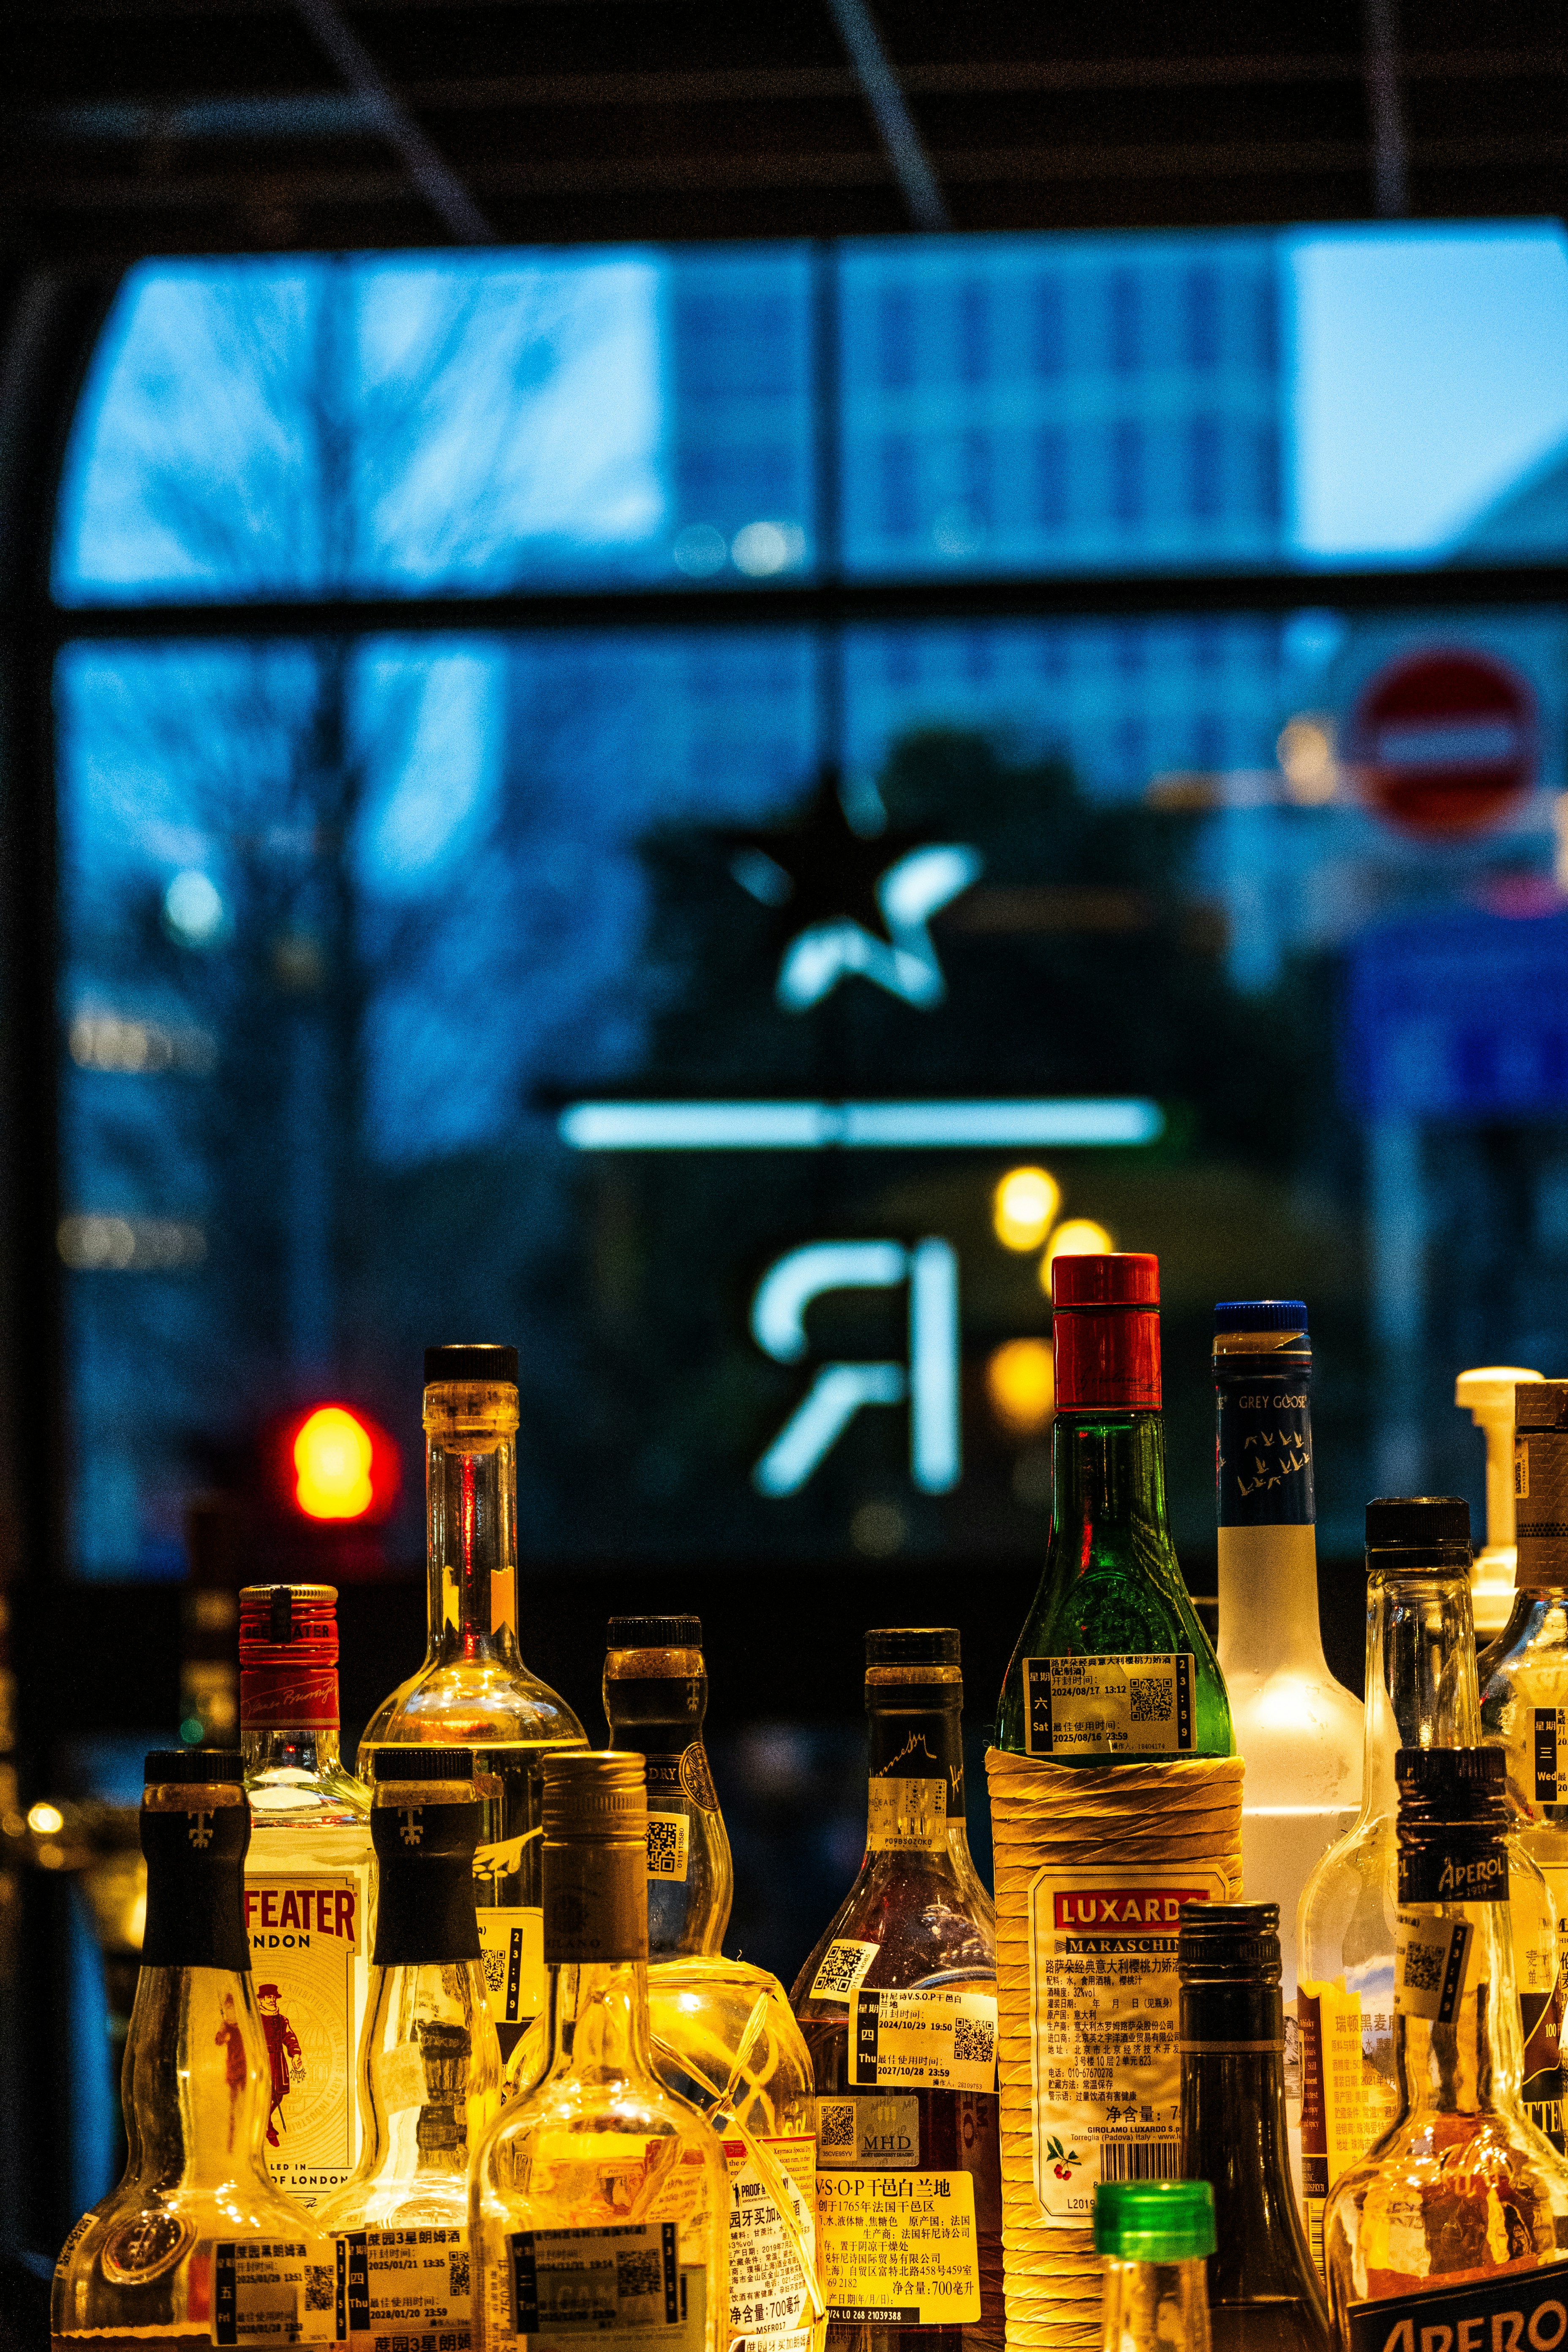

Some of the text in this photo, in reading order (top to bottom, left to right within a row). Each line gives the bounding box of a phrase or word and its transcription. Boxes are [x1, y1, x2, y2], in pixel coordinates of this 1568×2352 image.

[1239, 1395, 1269, 1409] GREY
[1029, 1672, 1050, 1682] 星期
[1051, 1686, 1126, 1696] 2024/08/17 13:12
[1034, 1698, 1048, 1710] 六
[1033, 1723, 1048, 1731] Sat
[1535, 1721, 1556, 1731] 星期
[1054, 1732, 1127, 1742] 2025/08/16 23:59
[1540, 1748, 1552, 1758] 三
[648, 1767, 676, 1780] DRY
[1537, 1772, 1557, 1781] Wed
[1438, 1857, 1504, 1892] APEROL
[1062, 1897, 1202, 1923] LUXARD
[248, 1935, 310, 1948] NDON
[858, 2004, 879, 2014] 星期
[879, 2020, 952, 2031] 2024/10/29 19:50
[1545, 2023, 1556, 2037] 100
[861, 2030, 874, 2041] 四
[859, 2053, 877, 2063] Thu
[878, 2066, 950, 2077] 2027/10/28 23:59
[1102, 2133, 1133, 2141] (Padova)
[1136, 2132, 1150, 2141] Italy
[863, 2136, 911, 2150] MHD
[793, 2146, 805, 2154] Special
[291, 2176, 348, 2184] LONDON
[741, 2183, 760, 2197] PROOF
[368, 2259, 445, 2270] 2025/01/21 13:35
[351, 2273, 364, 2284] 四
[839, 2278, 857, 2288] 2182
[220, 2287, 232, 2298] 五
[349, 2298, 368, 2308] Thu
[370, 2308, 447, 2319] 2028/01/20 23:59
[854, 2311, 865, 2319] 268
[868, 2311, 901, 2320] 21039388
[757, 2322, 786, 2334] MSFR017
